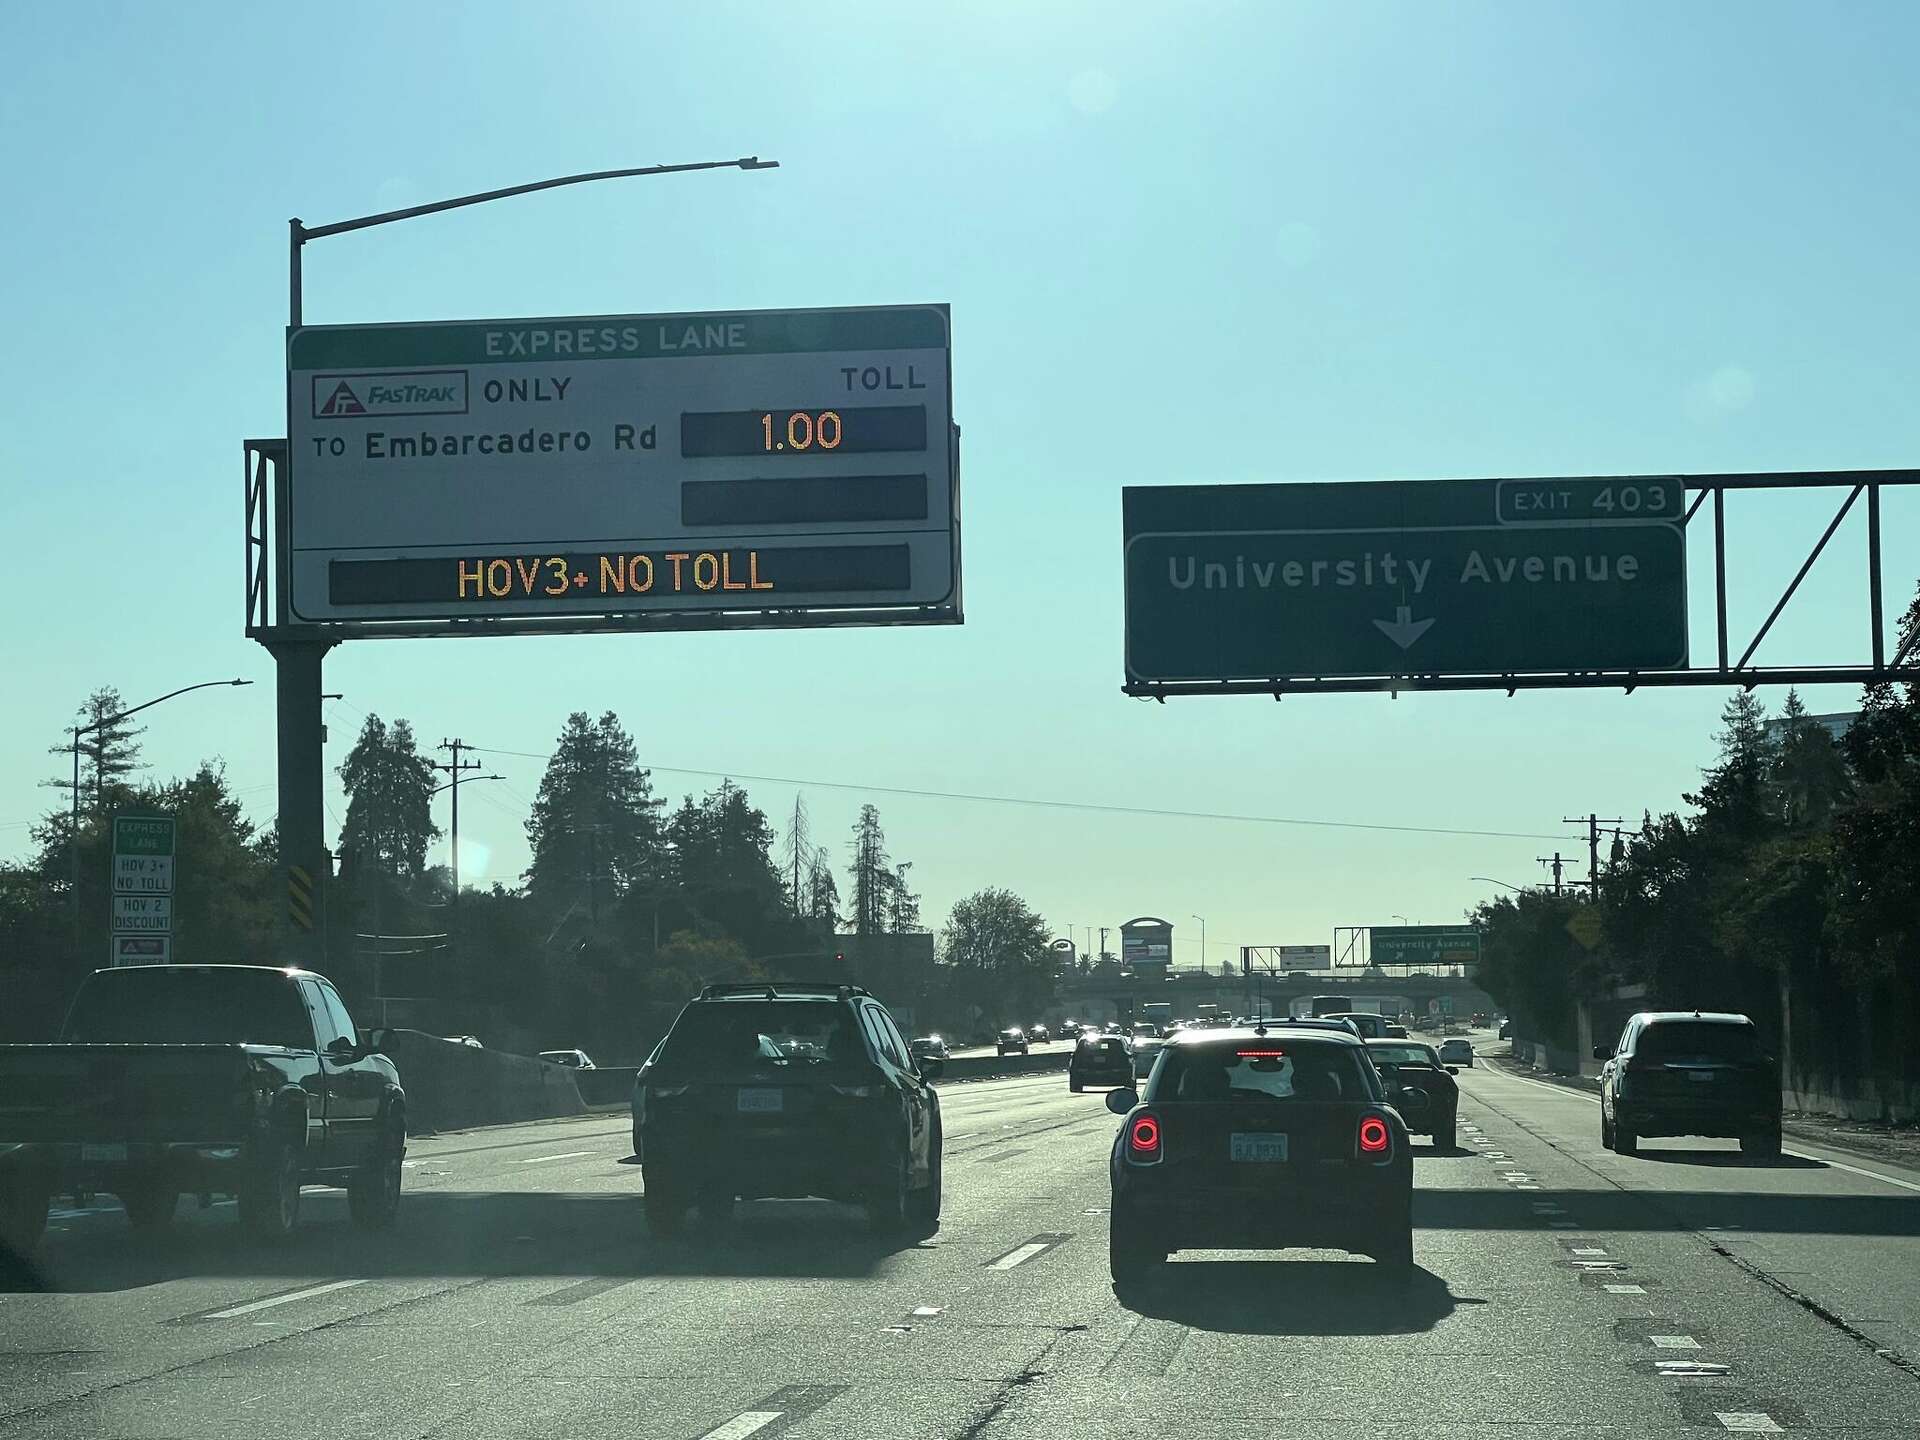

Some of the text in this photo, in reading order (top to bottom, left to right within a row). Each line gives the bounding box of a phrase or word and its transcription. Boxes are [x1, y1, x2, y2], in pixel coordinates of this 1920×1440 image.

[486, 322, 747, 356] EXPRESS LANE
[484, 377, 572, 403] ONLY
[841, 366, 927, 391] TOLL
[312, 424, 657, 459] TO Embarcadero Rd
[761, 411, 843, 452] 1.00
[1514, 487, 1667, 512] EXIT 403
[457, 551, 775, 599] HOV3+ NO TOLL
[1168, 550, 1640, 593] University Avenue
[119, 823, 170, 834] EXPRESS
[121, 860, 145, 871] HOV
[117, 877, 168, 889] NO TOLL
[124, 899, 162, 911] HOV 2
[115, 917, 169, 928] DISCOUNT
